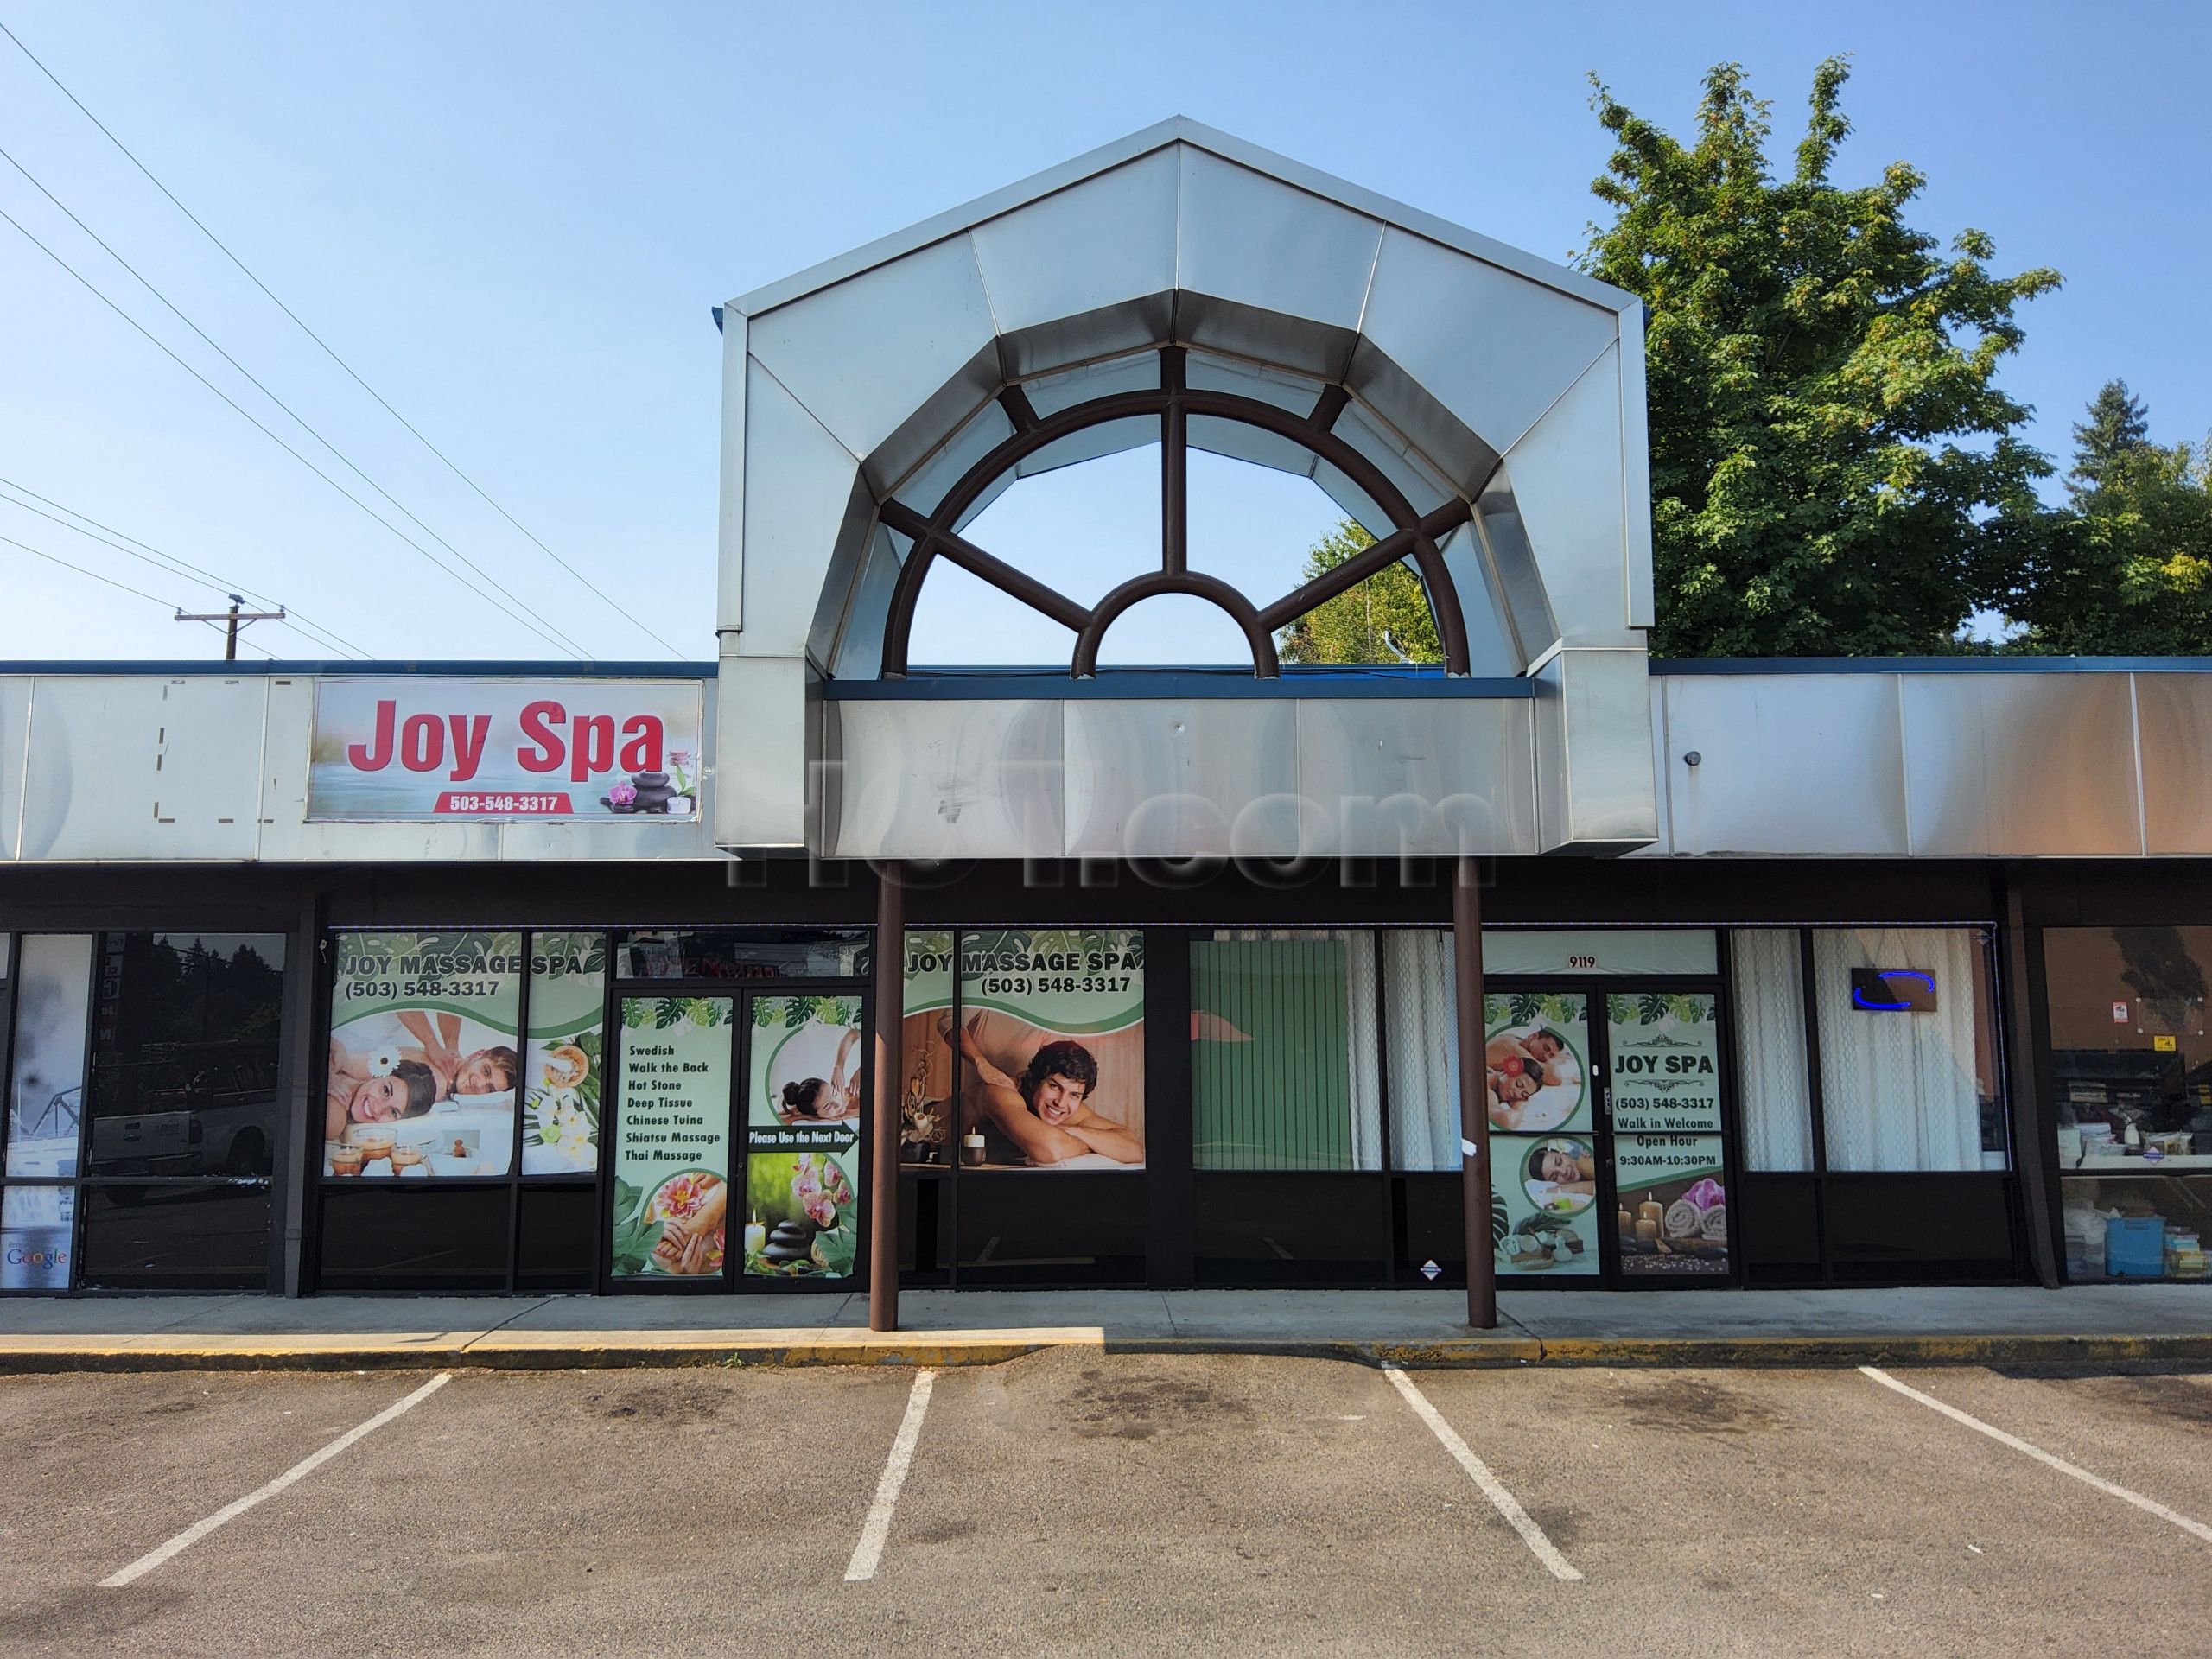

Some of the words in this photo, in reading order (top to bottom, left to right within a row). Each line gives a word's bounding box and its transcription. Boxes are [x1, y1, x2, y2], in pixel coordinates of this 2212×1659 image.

[348, 700, 492, 781] Joy
[517, 701, 664, 782] Spa
[449, 796, 557, 811] 503-548-3317
[346, 955, 393, 975] JOY
[400, 956, 521, 974] MASSAGE
[531, 955, 582, 975] SPA
[907, 953, 952, 972] JOY
[962, 953, 1080, 971] MASSAGE
[1087, 953, 1136, 971] SPA
[1569, 956, 1595, 968] 9119
[346, 982, 397, 1000] (503)
[404, 981, 499, 996] 548-3317
[982, 978, 1033, 995] (503)
[1038, 977, 1130, 993] 548-3317
[630, 1045, 674, 1055] Swedish
[629, 1062, 657, 1072] Walk
[661, 1062, 678, 1072] the
[683, 1062, 709, 1072] Back
[1615, 1055, 1658, 1073] JOY
[1665, 1055, 1714, 1073] SPA
[628, 1080, 647, 1090] Hot
[651, 1080, 681, 1090] Stone
[627, 1097, 654, 1109] Deep
[658, 1097, 692, 1107] Tissue
[1615, 1098, 1649, 1110] (503)
[1653, 1098, 1714, 1109] 548-3317
[626, 1115, 669, 1125] Chinese
[673, 1115, 703, 1124] Tuina
[1618, 1117, 1646, 1128] Walk
[1650, 1117, 1661, 1128] in
[1664, 1117, 1713, 1128] Welcome
[626, 1133, 666, 1142] Shiatsu
[671, 1132, 720, 1144] Massage
[749, 1131, 777, 1143] Please
[779, 1131, 794, 1143] Use
[796, 1130, 810, 1143] the
[811, 1131, 832, 1142] Next
[834, 1131, 854, 1142] Door
[1637, 1135, 1666, 1148] Open
[1670, 1135, 1698, 1147] Hour
[626, 1150, 648, 1160] Thai
[653, 1150, 702, 1162] Massage
[1619, 1155, 1716, 1165] 9:30AM-10:30PM
[7, 1248, 67, 1269] Google
